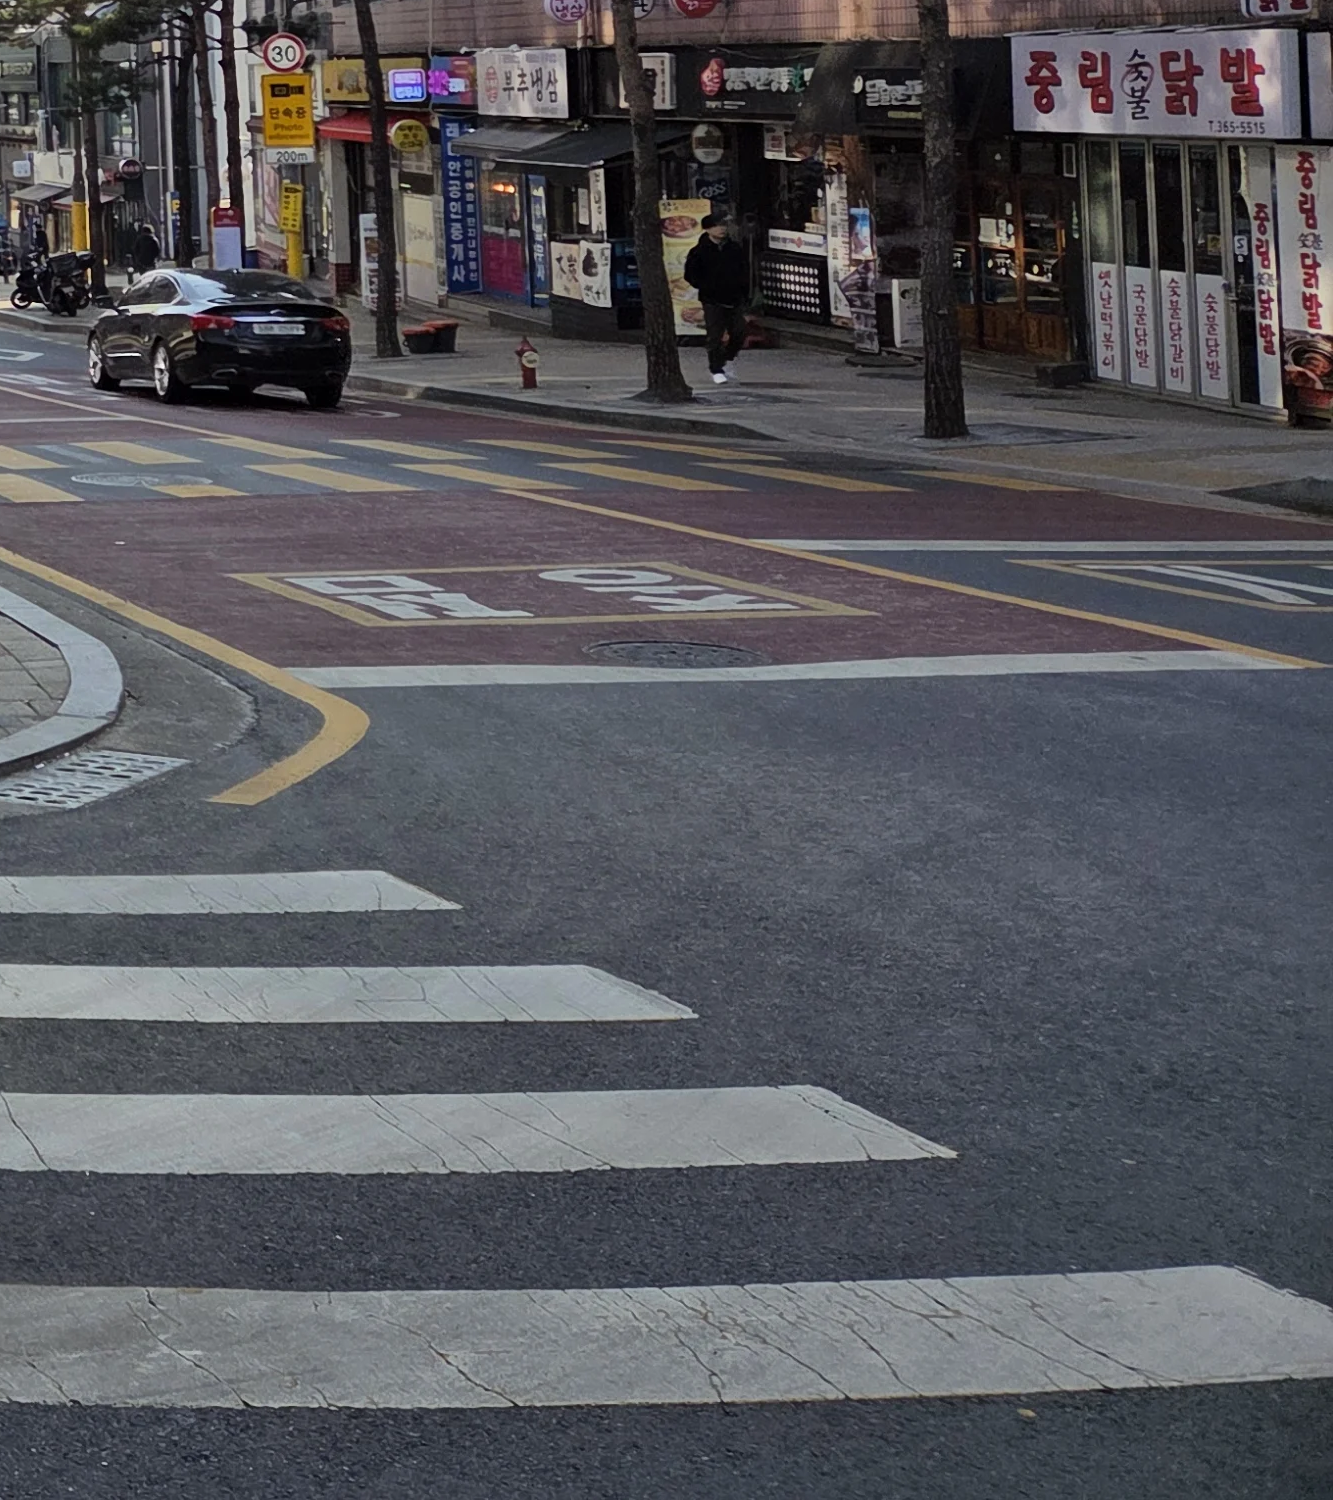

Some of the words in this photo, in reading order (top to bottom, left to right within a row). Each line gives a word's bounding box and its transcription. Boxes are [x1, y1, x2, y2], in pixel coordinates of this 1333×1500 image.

[271, 45, 297, 63] 30
[502, 66, 559, 104] 부추냉삼
[1025, 50, 1114, 115] 중림
[1123, 48, 1151, 121] 숯불
[1160, 47, 1265, 118] 닭발
[273, 123, 305, 132] Photo
[276, 150, 309, 163] 200m
[1208, 120, 1266, 135] T.365-5515
[1296, 151, 1318, 231] 중림
[1253, 202, 1271, 270] 중림
[1257, 288, 1277, 356] 닭발
[1299, 252, 1323, 331] 닭발
[1132, 283, 1150, 369] 국물닭발
[1166, 277, 1185, 385] 숯불닭갈비
[1202, 292, 1222, 381] 숯불닭발
